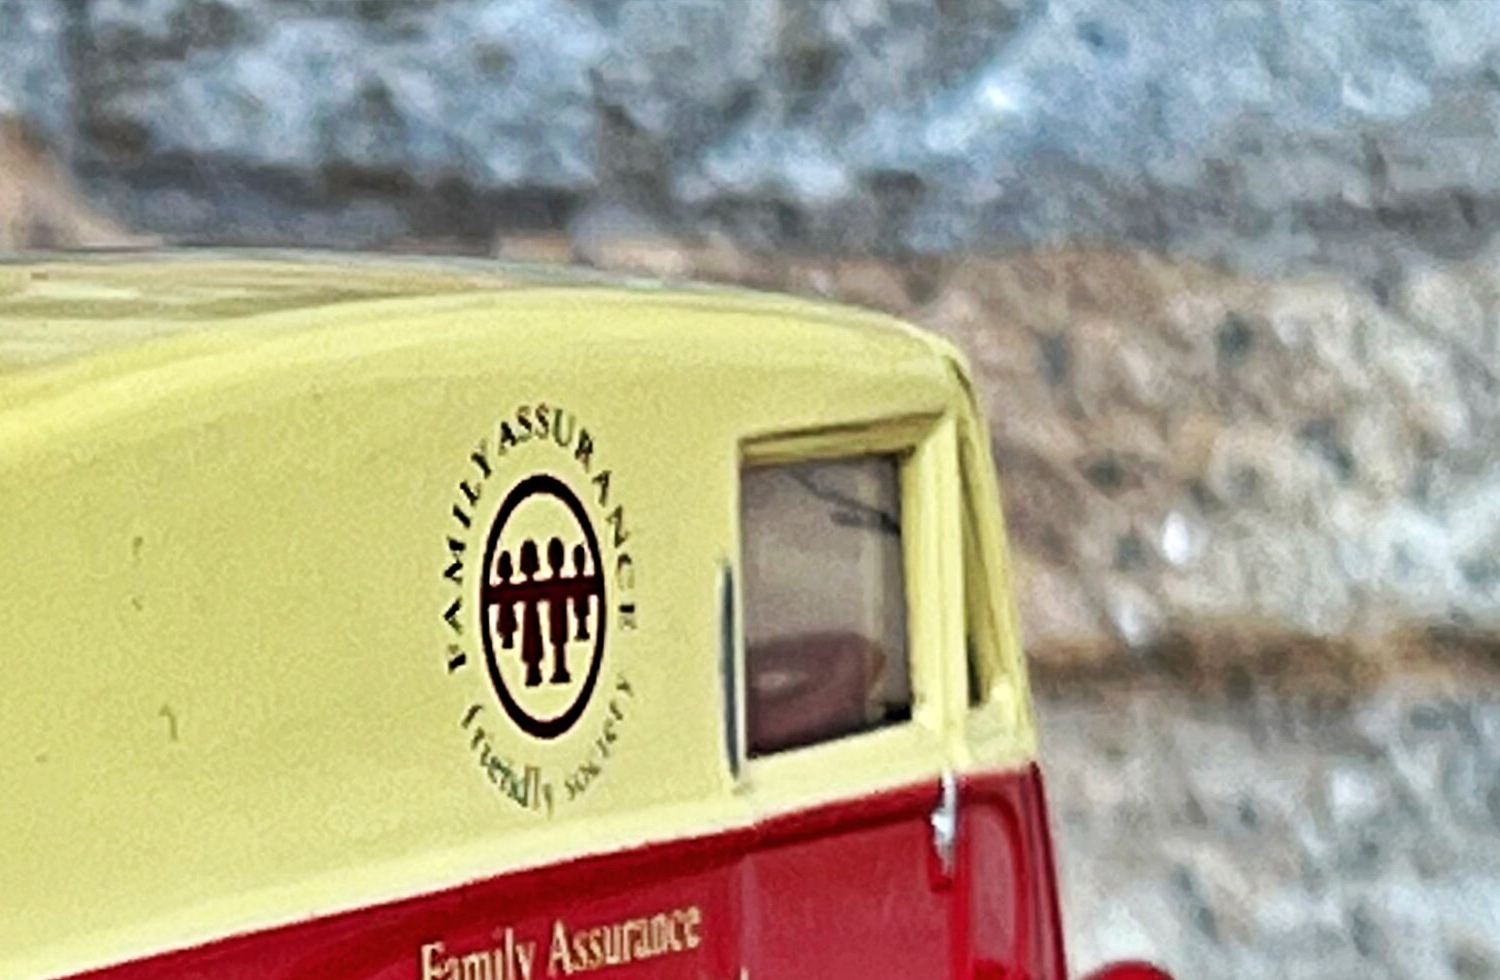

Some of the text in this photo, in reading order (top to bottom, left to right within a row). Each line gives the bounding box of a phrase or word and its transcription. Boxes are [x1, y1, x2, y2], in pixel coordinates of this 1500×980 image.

[443, 403, 637, 674] FAMILY ASSURANCE
[547, 905, 702, 977] Assurance
